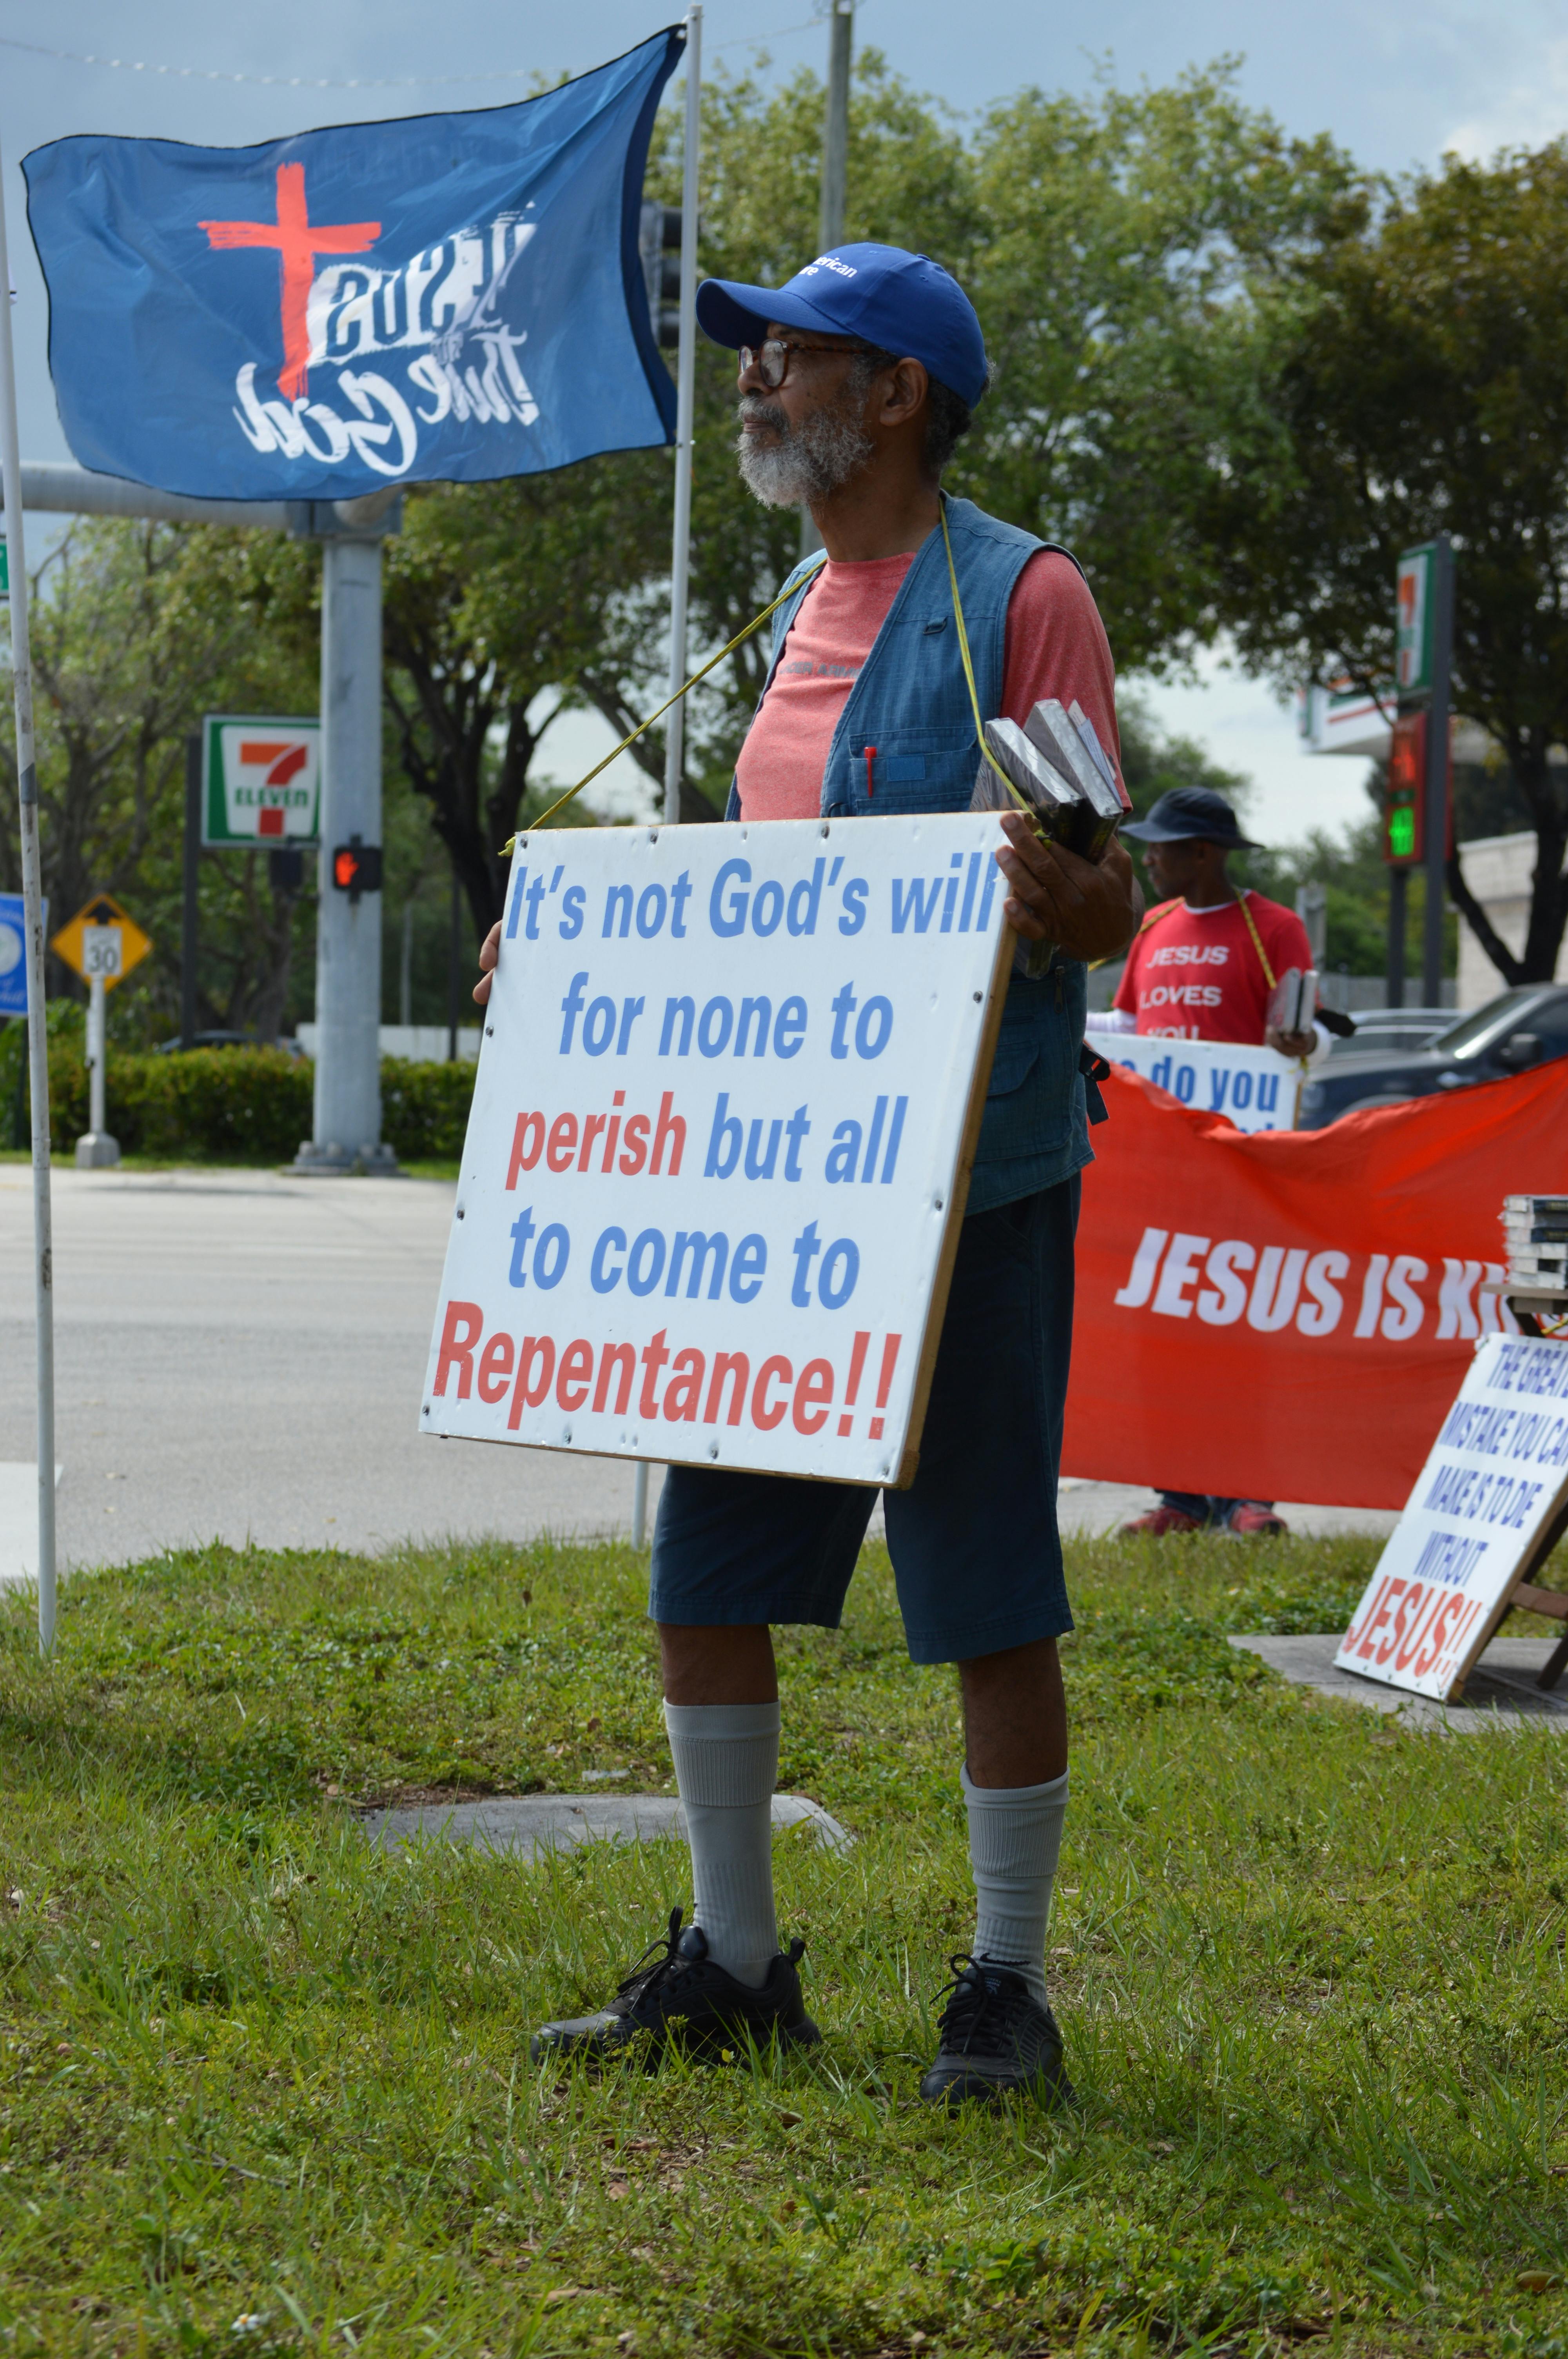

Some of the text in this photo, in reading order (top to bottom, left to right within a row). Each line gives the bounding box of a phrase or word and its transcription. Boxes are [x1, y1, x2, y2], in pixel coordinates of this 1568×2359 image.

[813, 256, 858, 278] erican
[240, 741, 309, 838] 7
[506, 852, 998, 940] It's not God's will
[89, 945, 118, 973] 30
[1146, 946, 1230, 969] JESUS
[559, 971, 893, 1060] for none to
[1141, 985, 1222, 1009] LOVES
[1209, 1067, 1280, 1113] you
[506, 1090, 909, 1190] perish but all
[508, 1206, 860, 1310] to come to
[1114, 1227, 1568, 1341] JESUS IS KI
[433, 1301, 902, 1440] Repentance!!
[1486, 1343, 1568, 1398] THE GREA
[1438, 1401, 1517, 1454] MISTAKE
[1504, 1412, 1552, 1461] YOU
[1423, 1465, 1544, 1528] MAKE IS TO DIE
[1413, 1530, 1489, 1587] WITHOUT
[1342, 1575, 1483, 1677] JESUS!!
